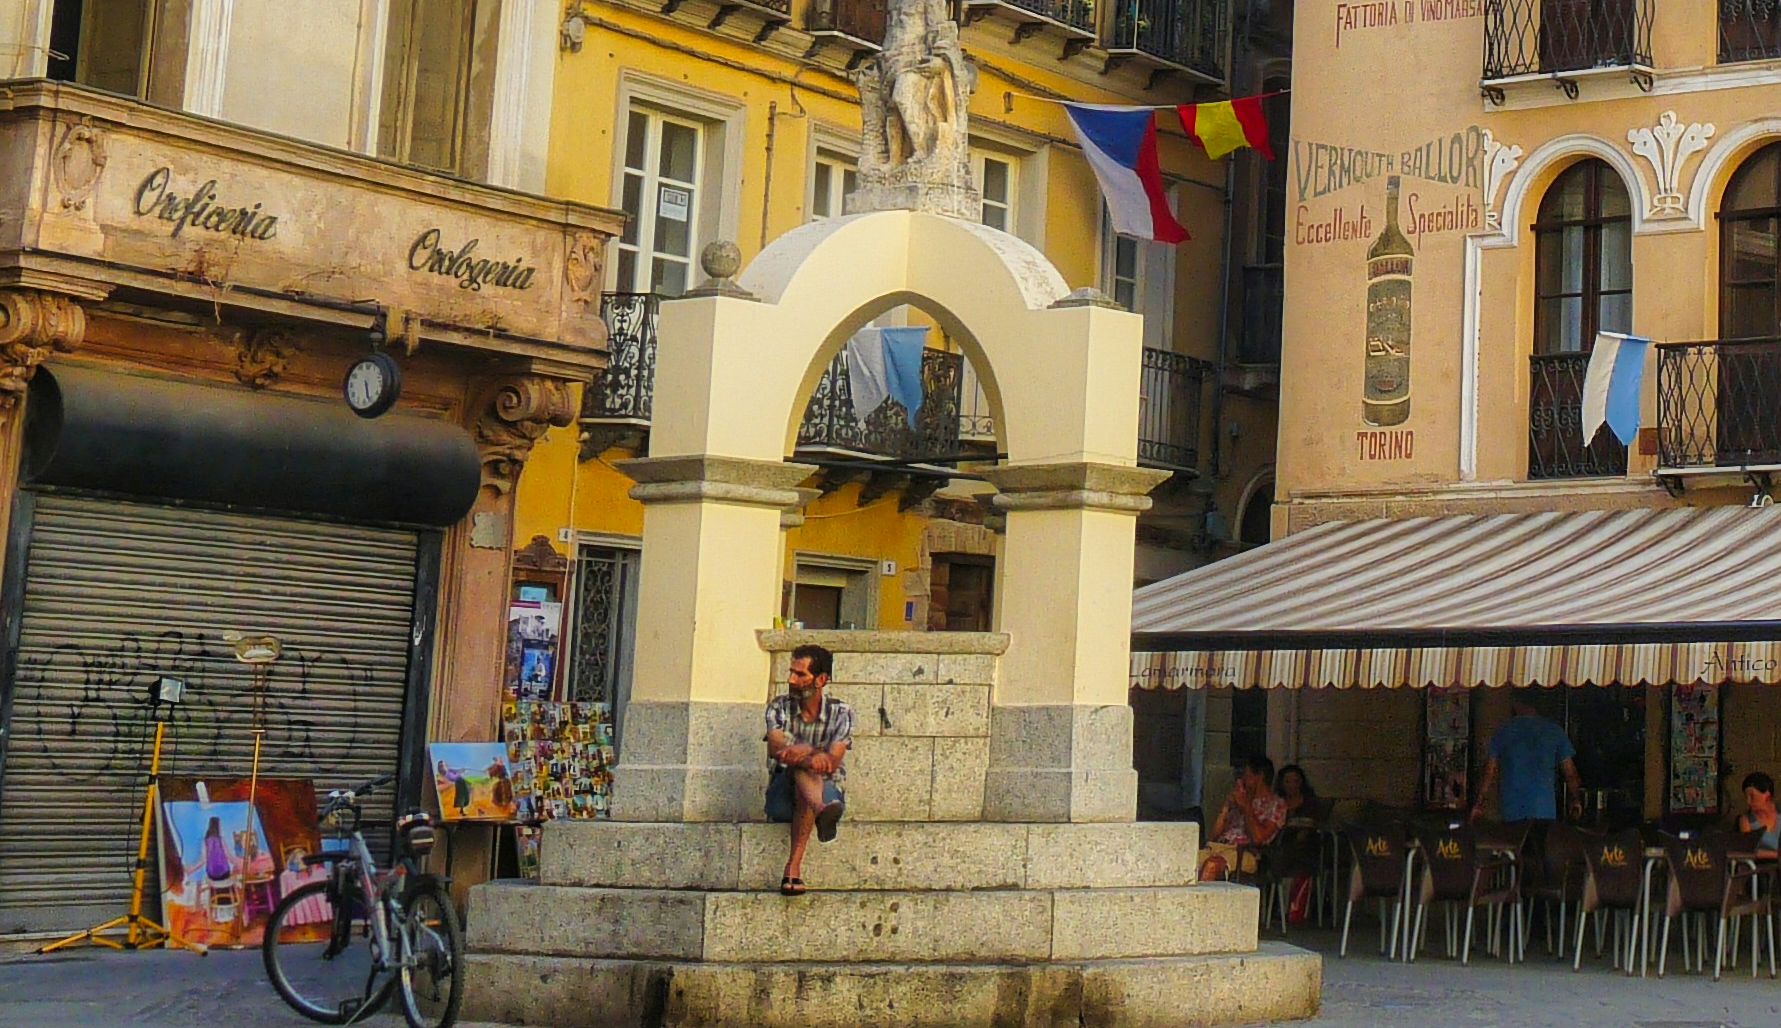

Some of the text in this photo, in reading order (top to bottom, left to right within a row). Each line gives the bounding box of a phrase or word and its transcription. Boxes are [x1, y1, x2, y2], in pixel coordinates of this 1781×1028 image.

[1335, 0, 1398, 49] FATTORIA
[1404, 0, 1415, 24] DI
[1293, 124, 1480, 203] VERMOUTH BALLOR
[133, 166, 538, 292] Oreficeria Orologeria
[1295, 204, 1372, 247] Eccellente
[1356, 429, 1415, 461] TORINO
[1701, 650, 1778, 674] Antico
